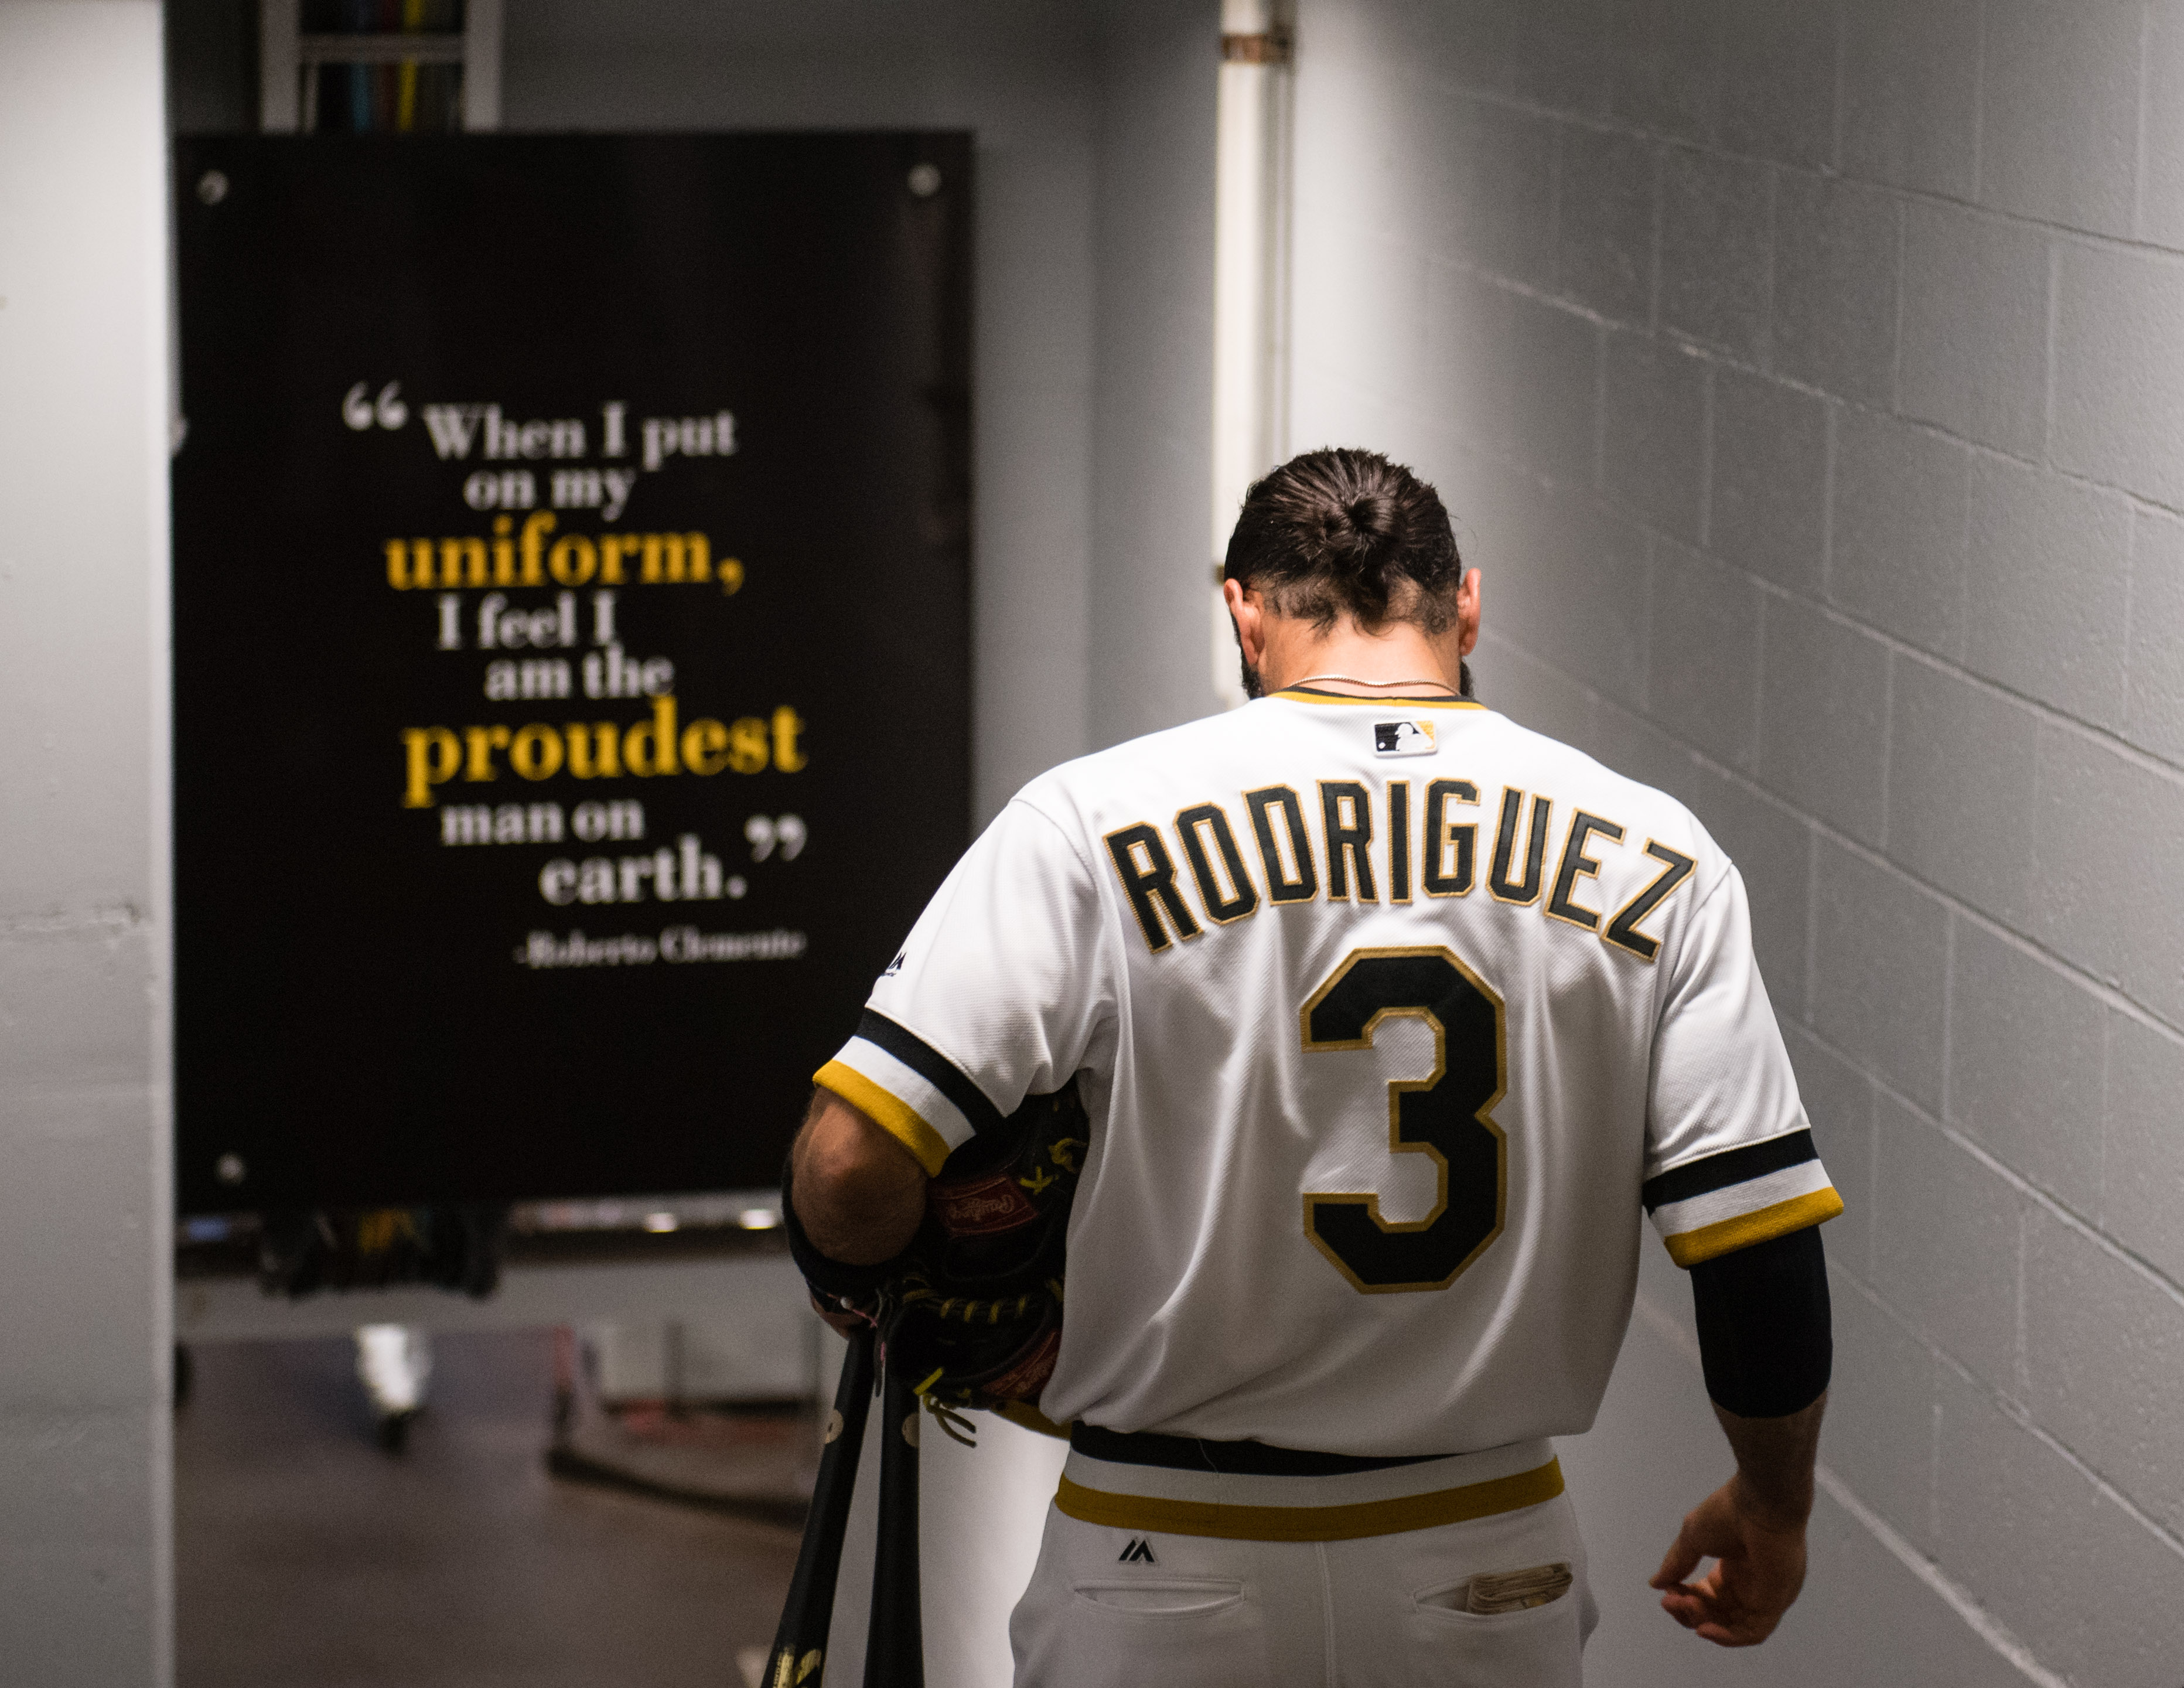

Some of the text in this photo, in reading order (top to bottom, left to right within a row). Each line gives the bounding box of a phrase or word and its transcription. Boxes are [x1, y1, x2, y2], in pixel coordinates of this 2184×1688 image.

[603, 401, 626, 458] I
[642, 410, 736, 471] put
[463, 468, 635, 522] on my
[384, 509, 744, 596] uniform,
[438, 589, 616, 650] I feel I
[483, 640, 674, 700] am the
[403, 695, 806, 809] proudest
[439, 799, 645, 846] man on
[1102, 777, 1698, 962] RODRIGUEZ
[1299, 944, 1507, 1294] 3
